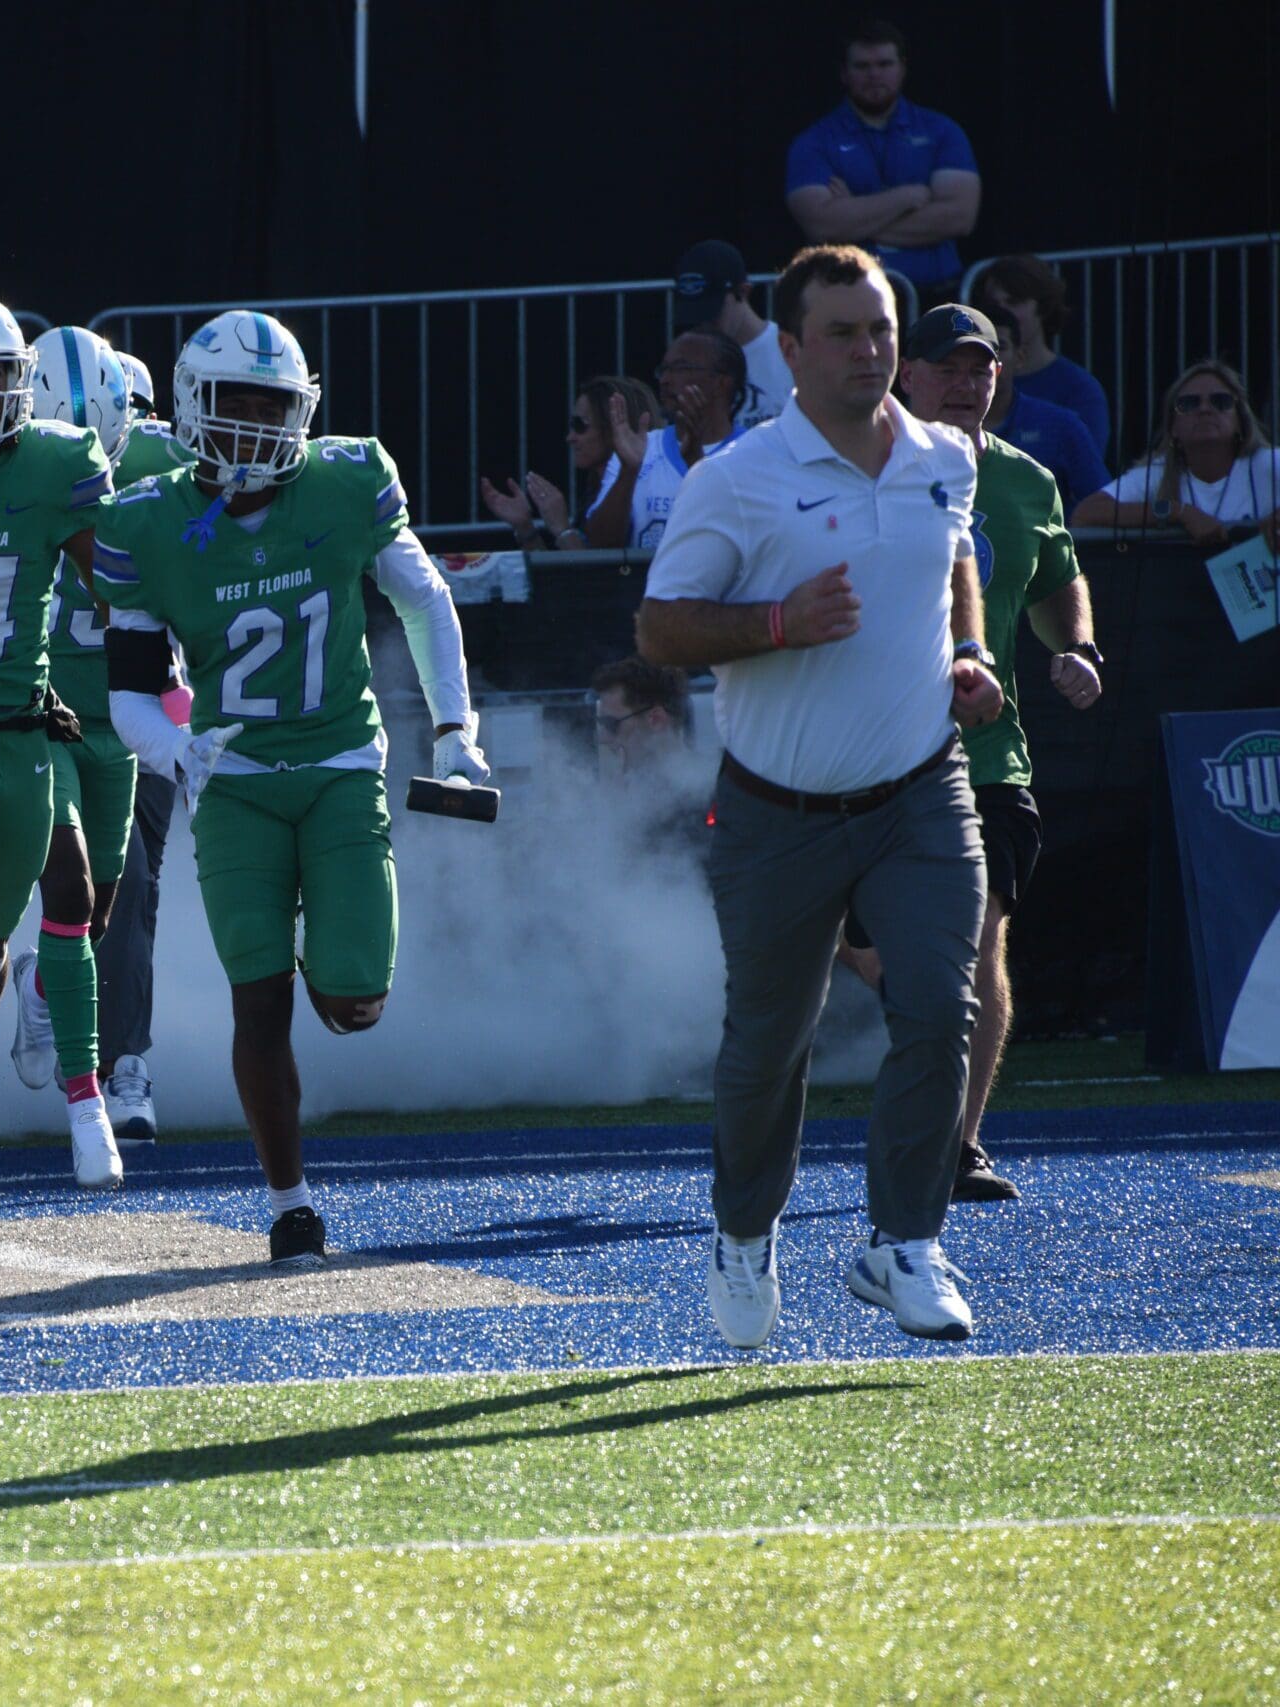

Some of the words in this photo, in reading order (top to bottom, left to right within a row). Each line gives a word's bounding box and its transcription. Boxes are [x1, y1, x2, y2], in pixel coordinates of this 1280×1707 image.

[216, 582, 250, 602] WEST
[258, 568, 312, 596] FLORIDA
[221, 588, 331, 718] 21
